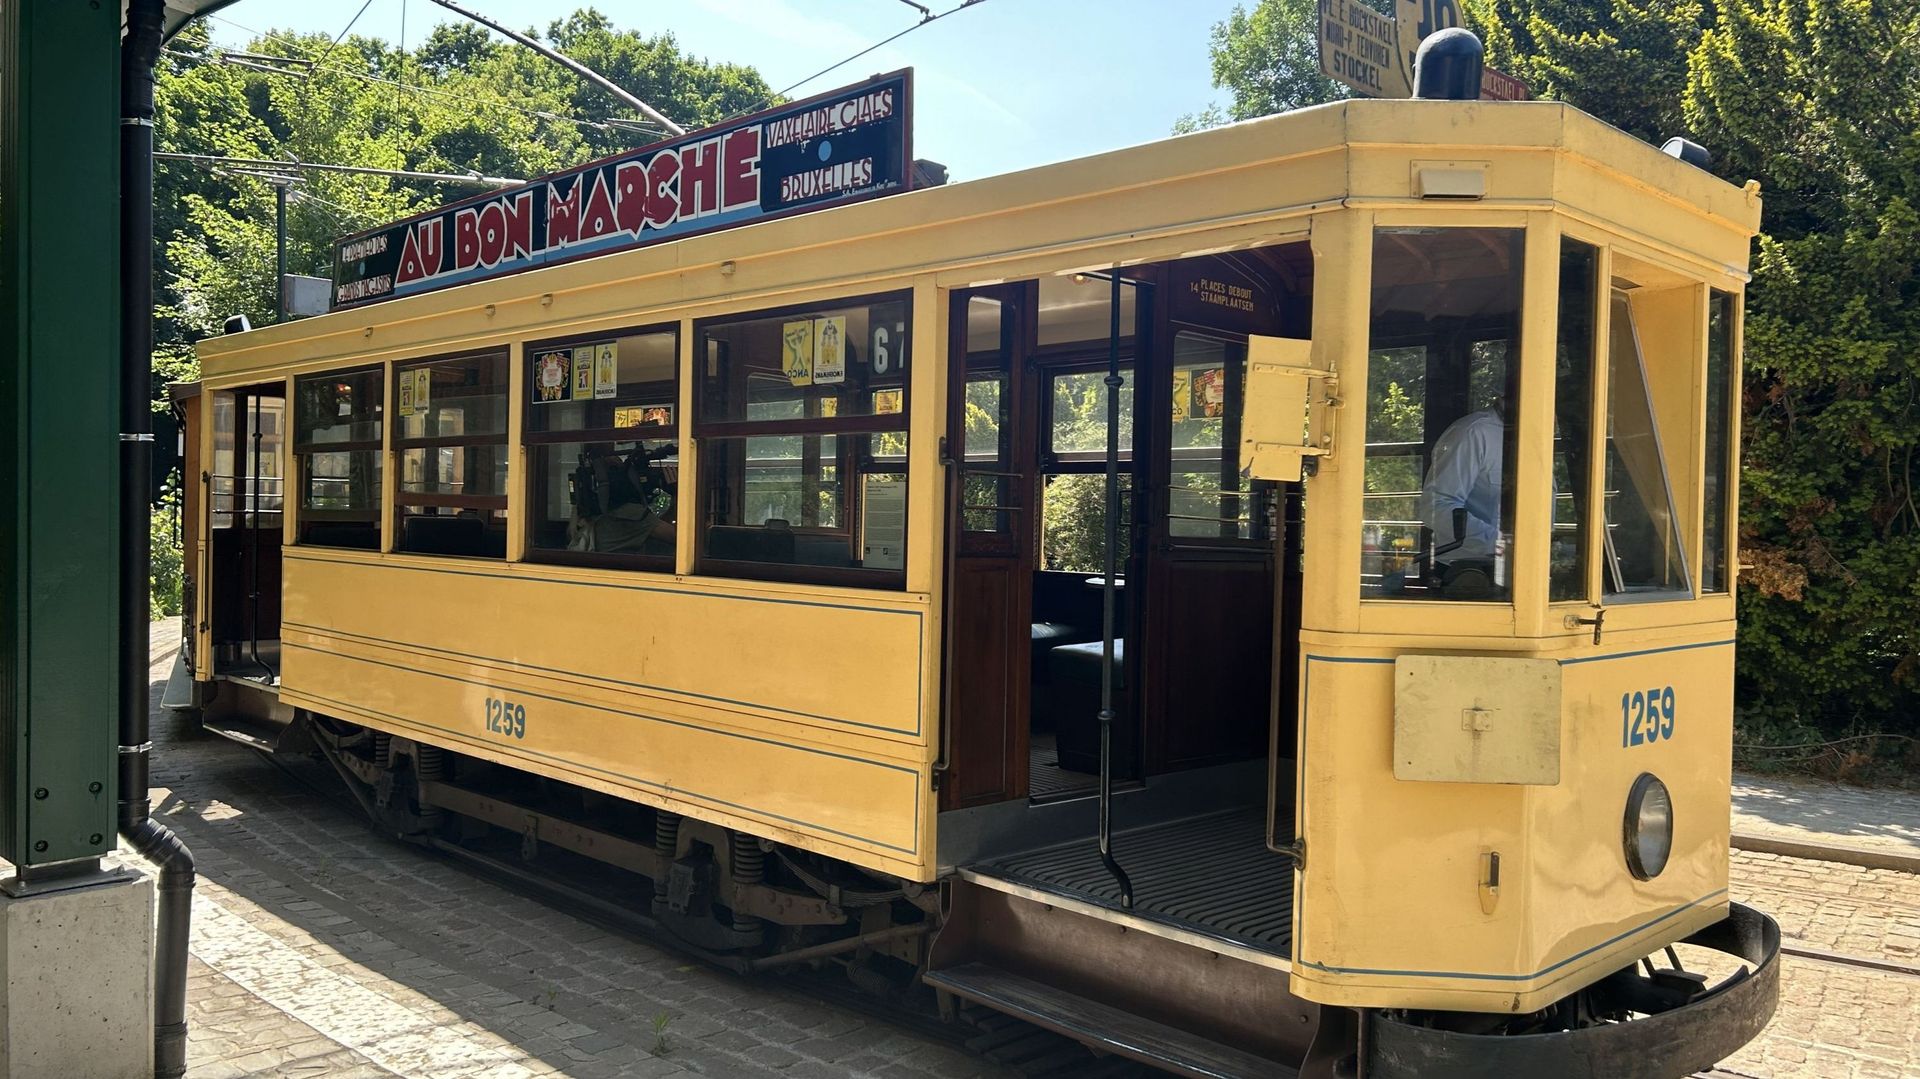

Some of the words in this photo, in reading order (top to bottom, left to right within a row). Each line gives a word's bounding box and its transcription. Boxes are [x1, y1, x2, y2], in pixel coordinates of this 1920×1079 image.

[1349, 4, 1392, 46] BOCKSTAEL
[1334, 49, 1382, 91] STOCKEL
[766, 105, 835, 148] VAXELAIRE
[780, 157, 872, 201] BRUXELLES
[395, 216, 444, 287] AU
[455, 191, 533, 270] BON
[546, 124, 762, 249] MARCHE
[1190, 282, 1199, 293] 14
[1200, 279, 1225, 294] PLACES
[1228, 285, 1253, 300] DEBOUT
[485, 697, 526, 740] 1259
[1621, 686, 1675, 749] 1259
